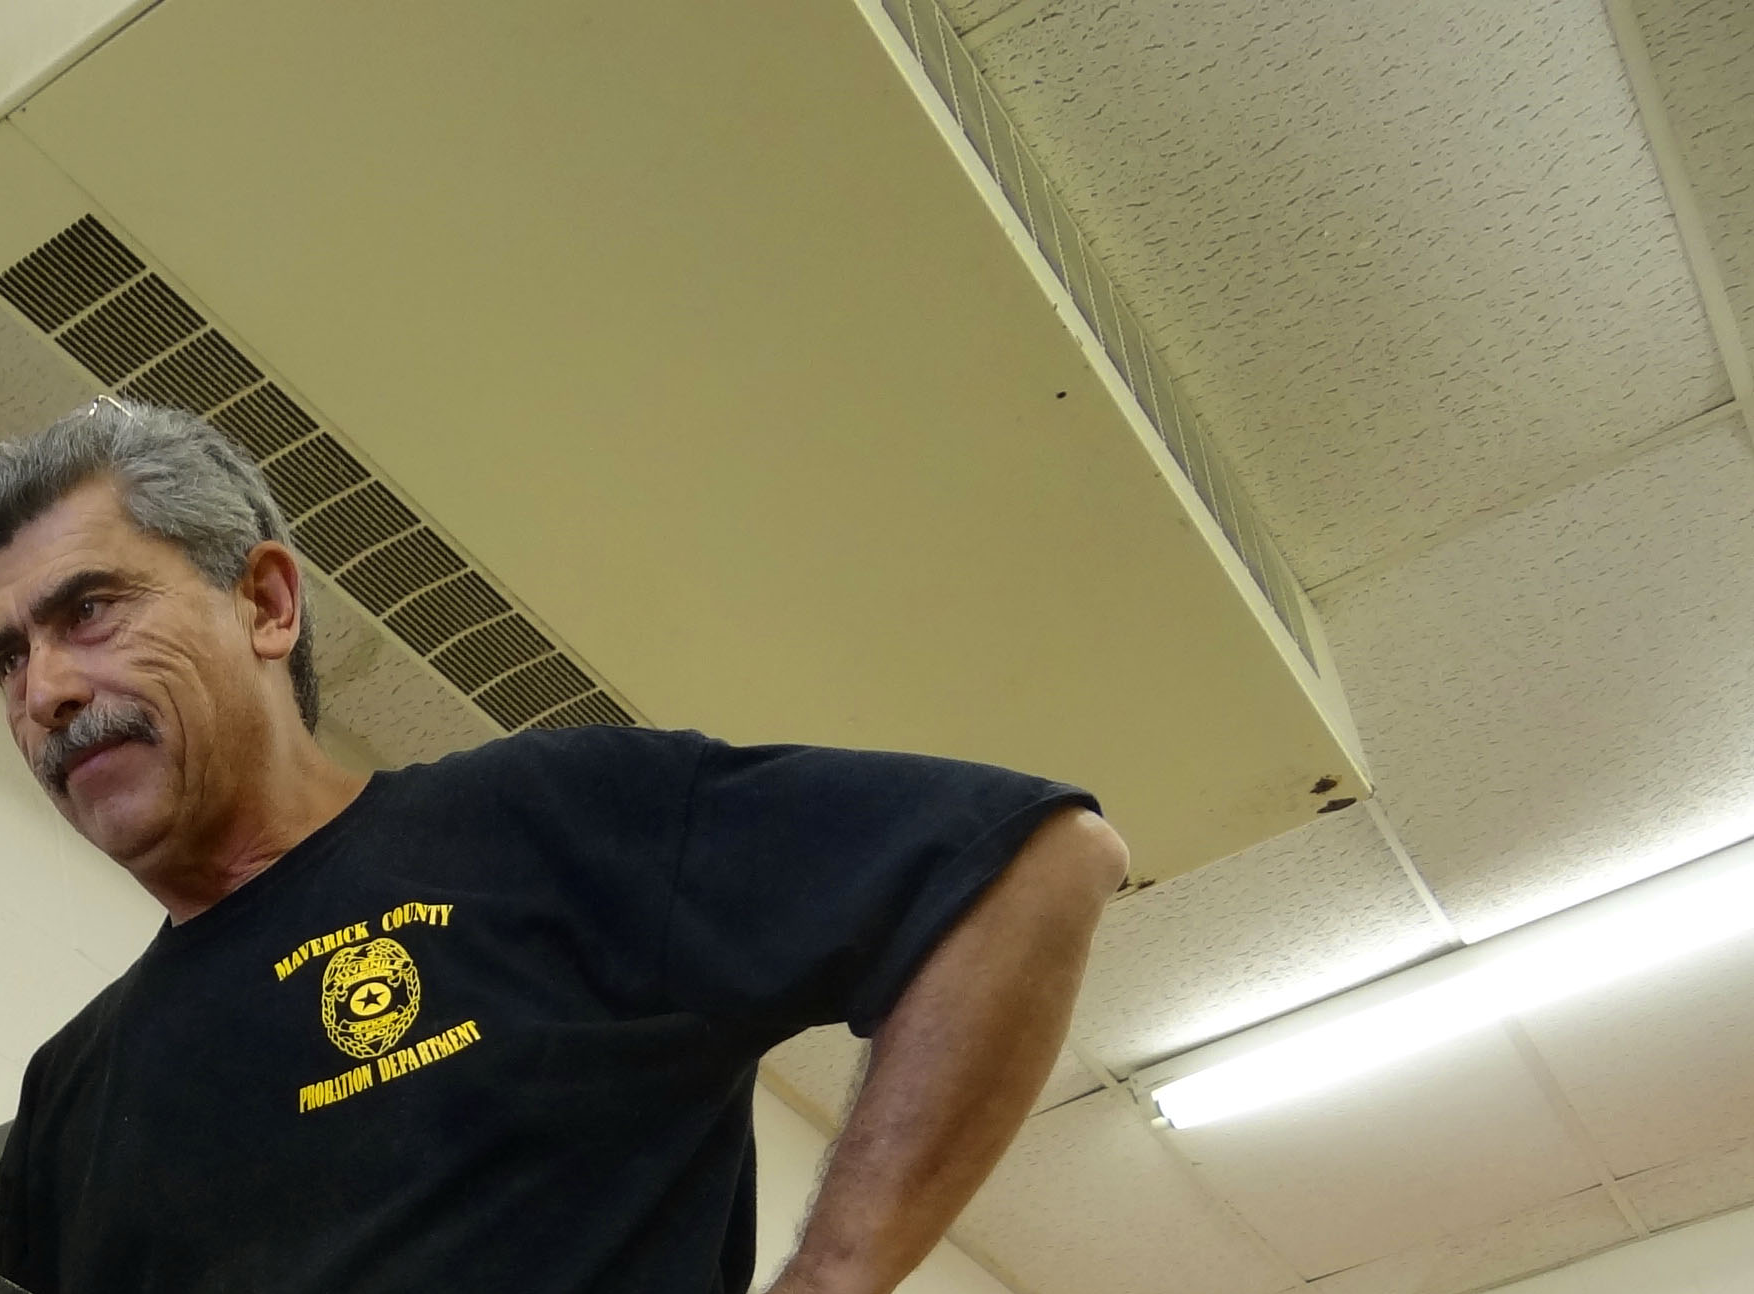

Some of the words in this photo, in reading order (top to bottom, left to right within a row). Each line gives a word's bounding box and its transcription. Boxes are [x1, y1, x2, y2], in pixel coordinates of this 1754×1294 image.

[273, 920, 370, 982] MAVERICK
[381, 902, 454, 932] COUNTY
[298, 1063, 374, 1114] PROBATION
[377, 1019, 482, 1083] DEPARTMENT
